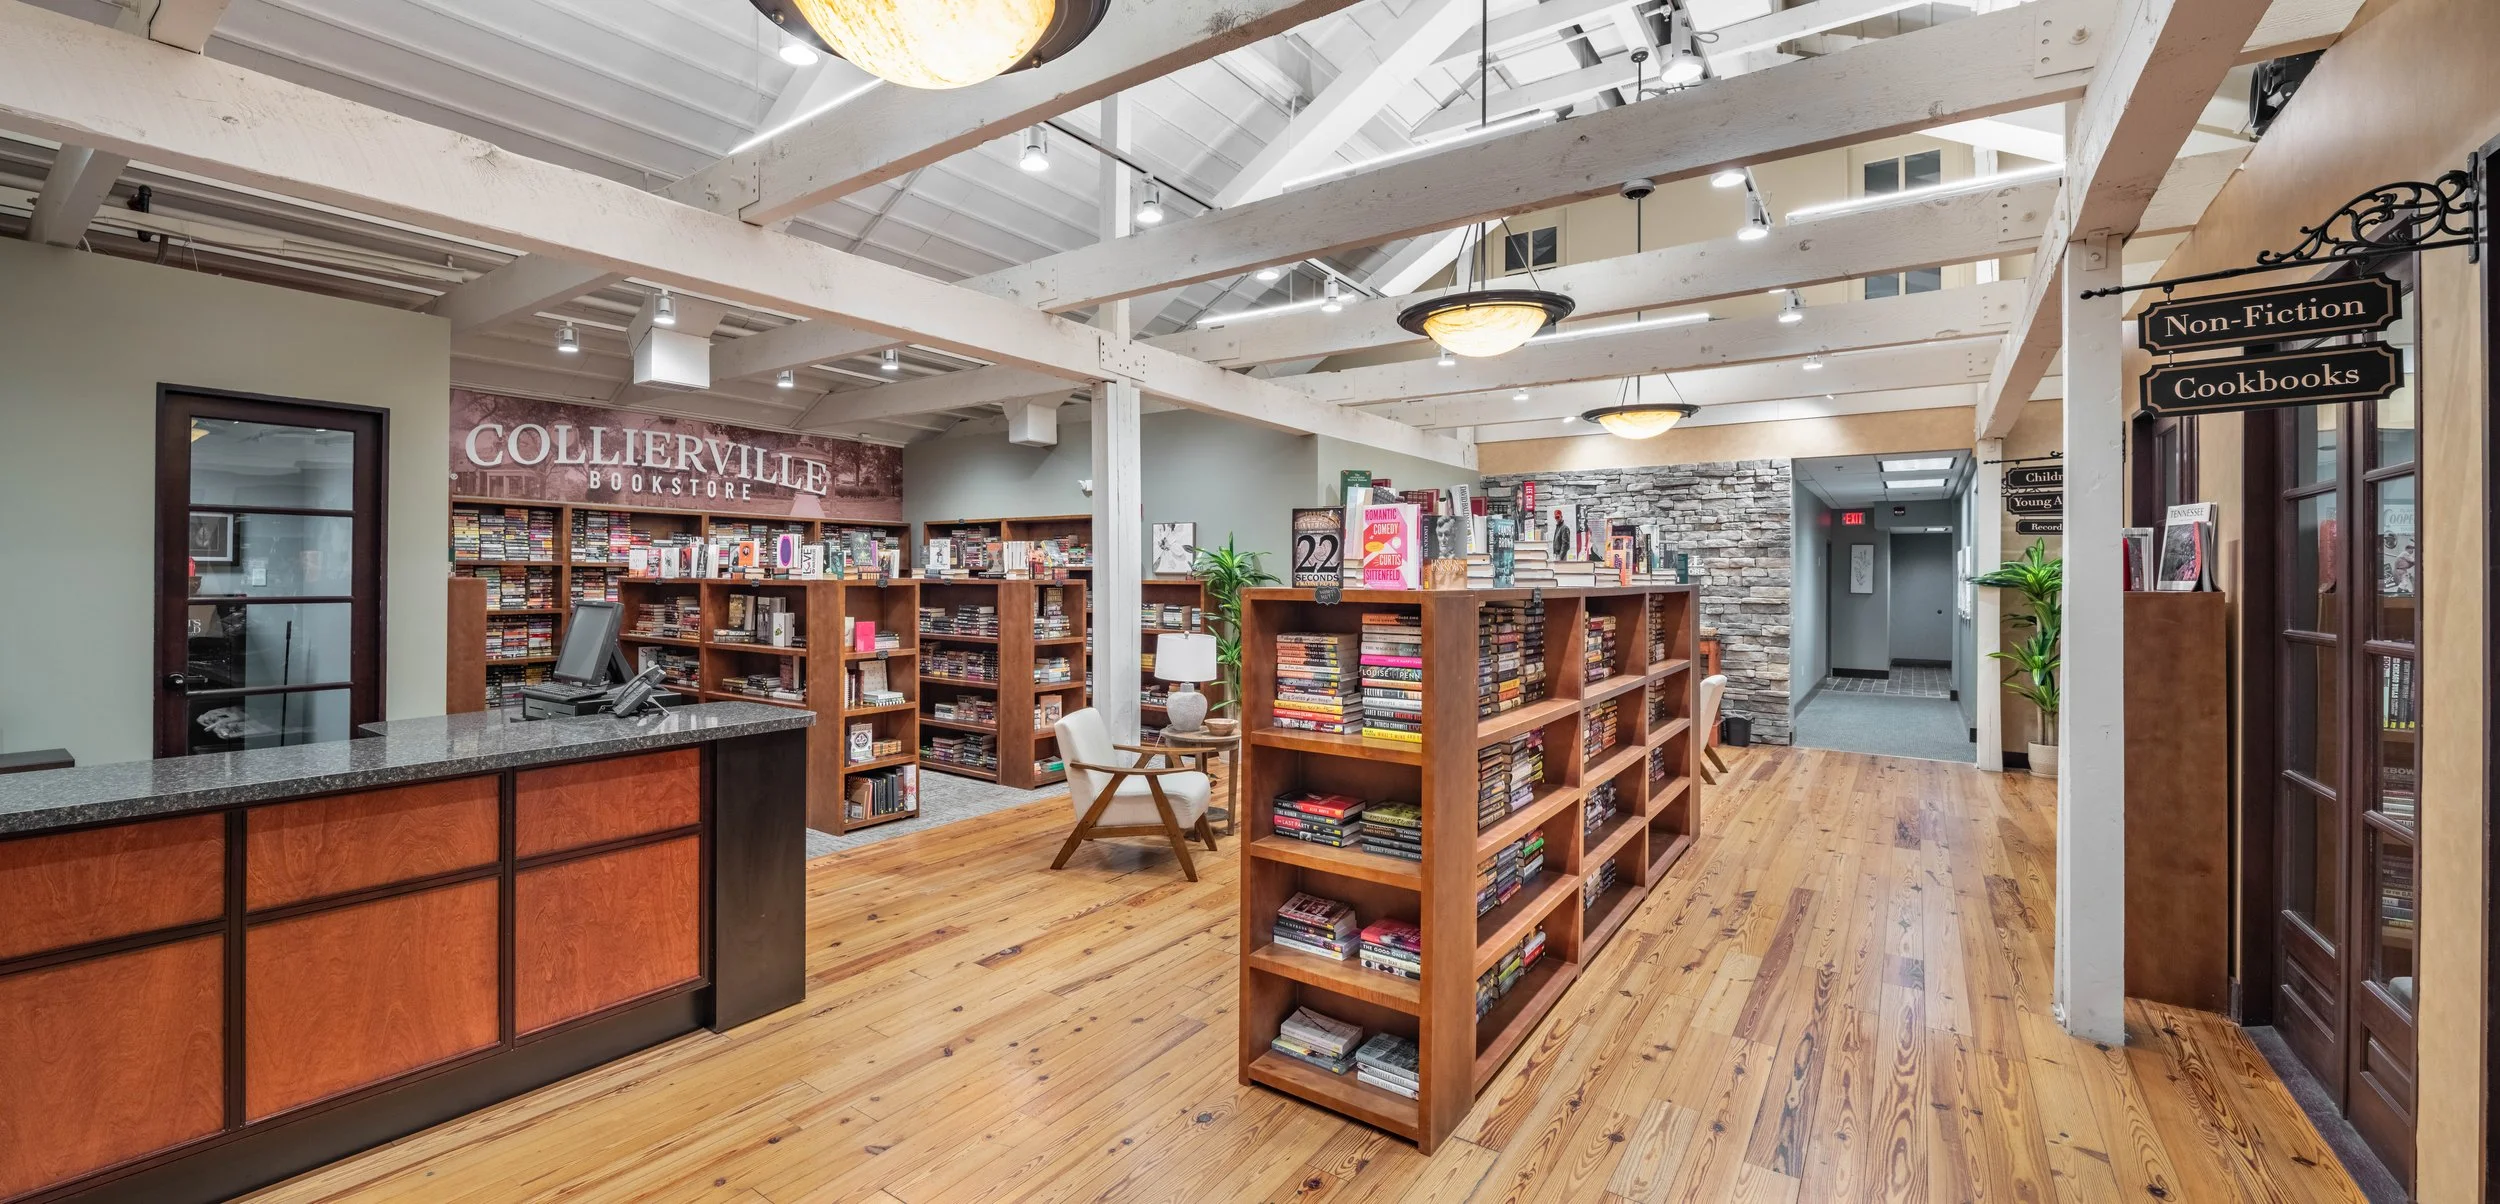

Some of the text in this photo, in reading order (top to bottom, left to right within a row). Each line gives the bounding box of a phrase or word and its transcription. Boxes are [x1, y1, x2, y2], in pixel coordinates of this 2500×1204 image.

[2164, 296, 2366, 338] Non-Fiction
[2174, 363, 2360, 400] Cookbooks
[465, 422, 828, 496] COLLIERVILLE
[589, 470, 751, 501] BOOKSTORE
[2014, 497, 2052, 508] Young
[1365, 508, 1397, 520] ROMANTIC
[1846, 512, 1863, 524] EXIT
[2170, 507, 2204, 518] TENNESSEE
[1374, 524, 1398, 535] COMEDY
[1295, 534, 1340, 572] 22
[1380, 554, 1402, 565] CURTIS
[1366, 570, 1400, 580] SITTENFELD
[1374, 947, 1390, 955] GOOD
[1391, 950, 1406, 959] ONES
